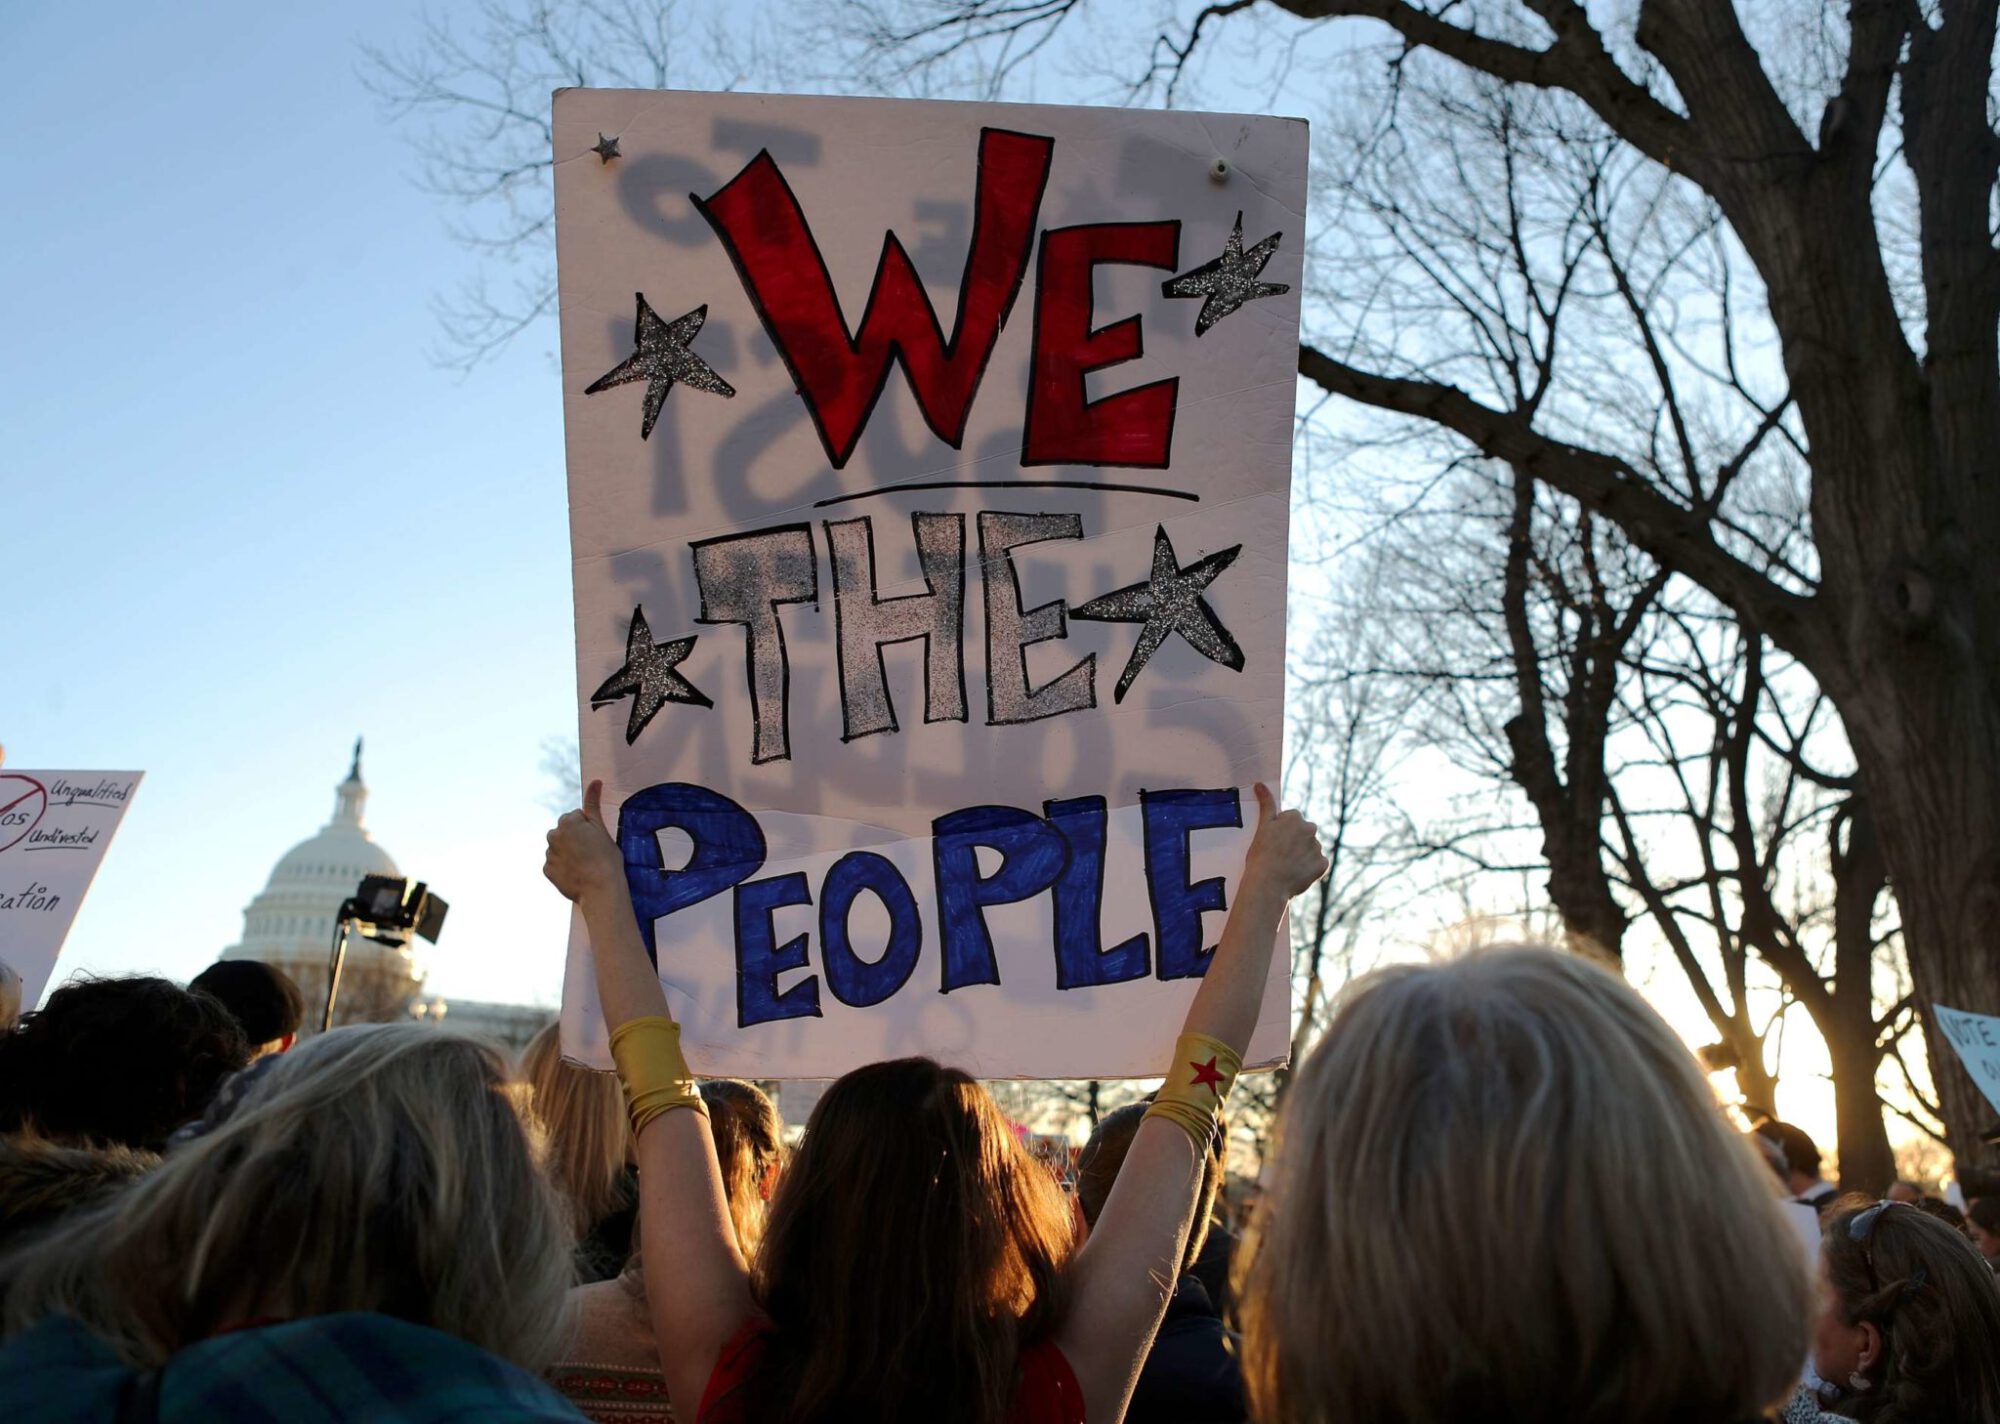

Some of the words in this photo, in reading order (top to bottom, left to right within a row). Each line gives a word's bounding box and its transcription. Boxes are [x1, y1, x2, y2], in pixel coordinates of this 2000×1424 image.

[690, 126, 1181, 468] WE
[689, 511, 1098, 764] THE
[28, 826, 100, 844] Undivested
[50, 779, 133, 806] Unqualified
[617, 783, 1243, 1027] PEOPLE
